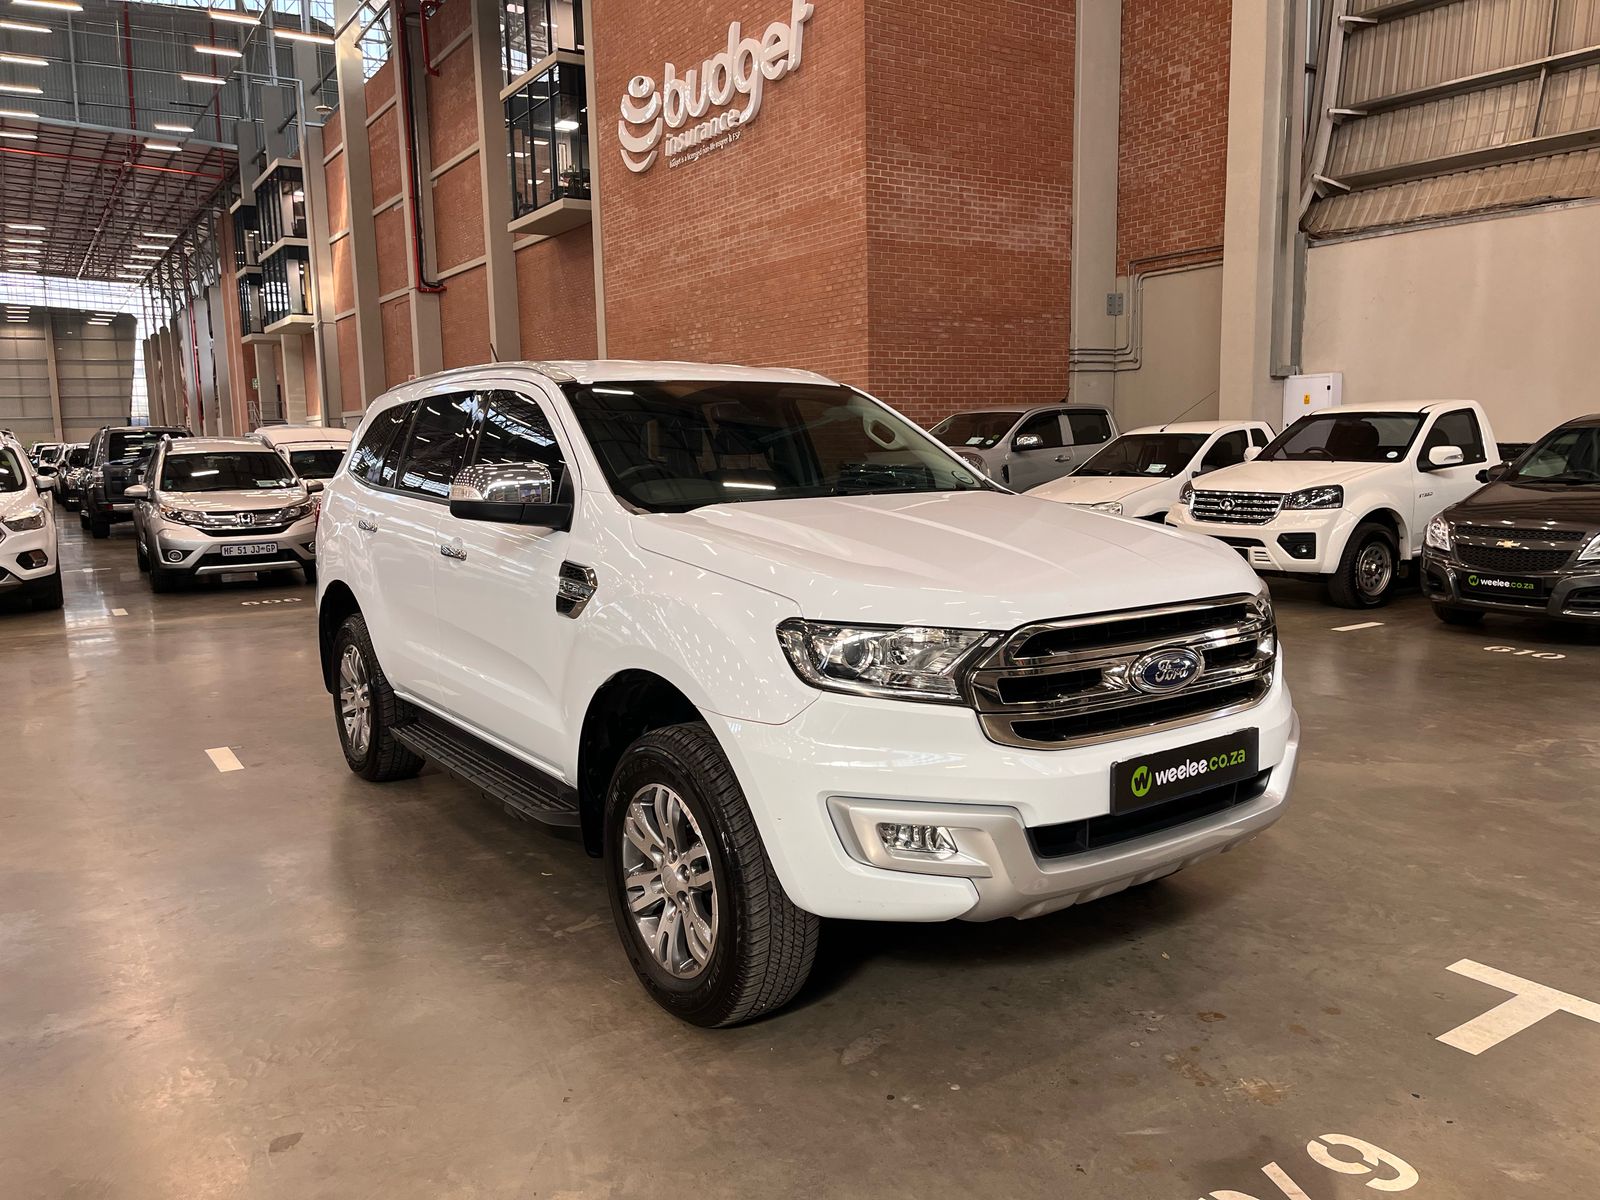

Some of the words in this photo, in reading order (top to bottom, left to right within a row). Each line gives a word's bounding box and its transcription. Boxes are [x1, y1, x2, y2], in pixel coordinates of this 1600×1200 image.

[663, 0, 814, 128] budget
[665, 108, 741, 156] insurance
[237, 546, 247, 554] 51
[1480, 579, 1534, 589] weelee.co.za
[1155, 658, 1190, 683] Ford
[1155, 749, 1246, 786] weelee.co.za
